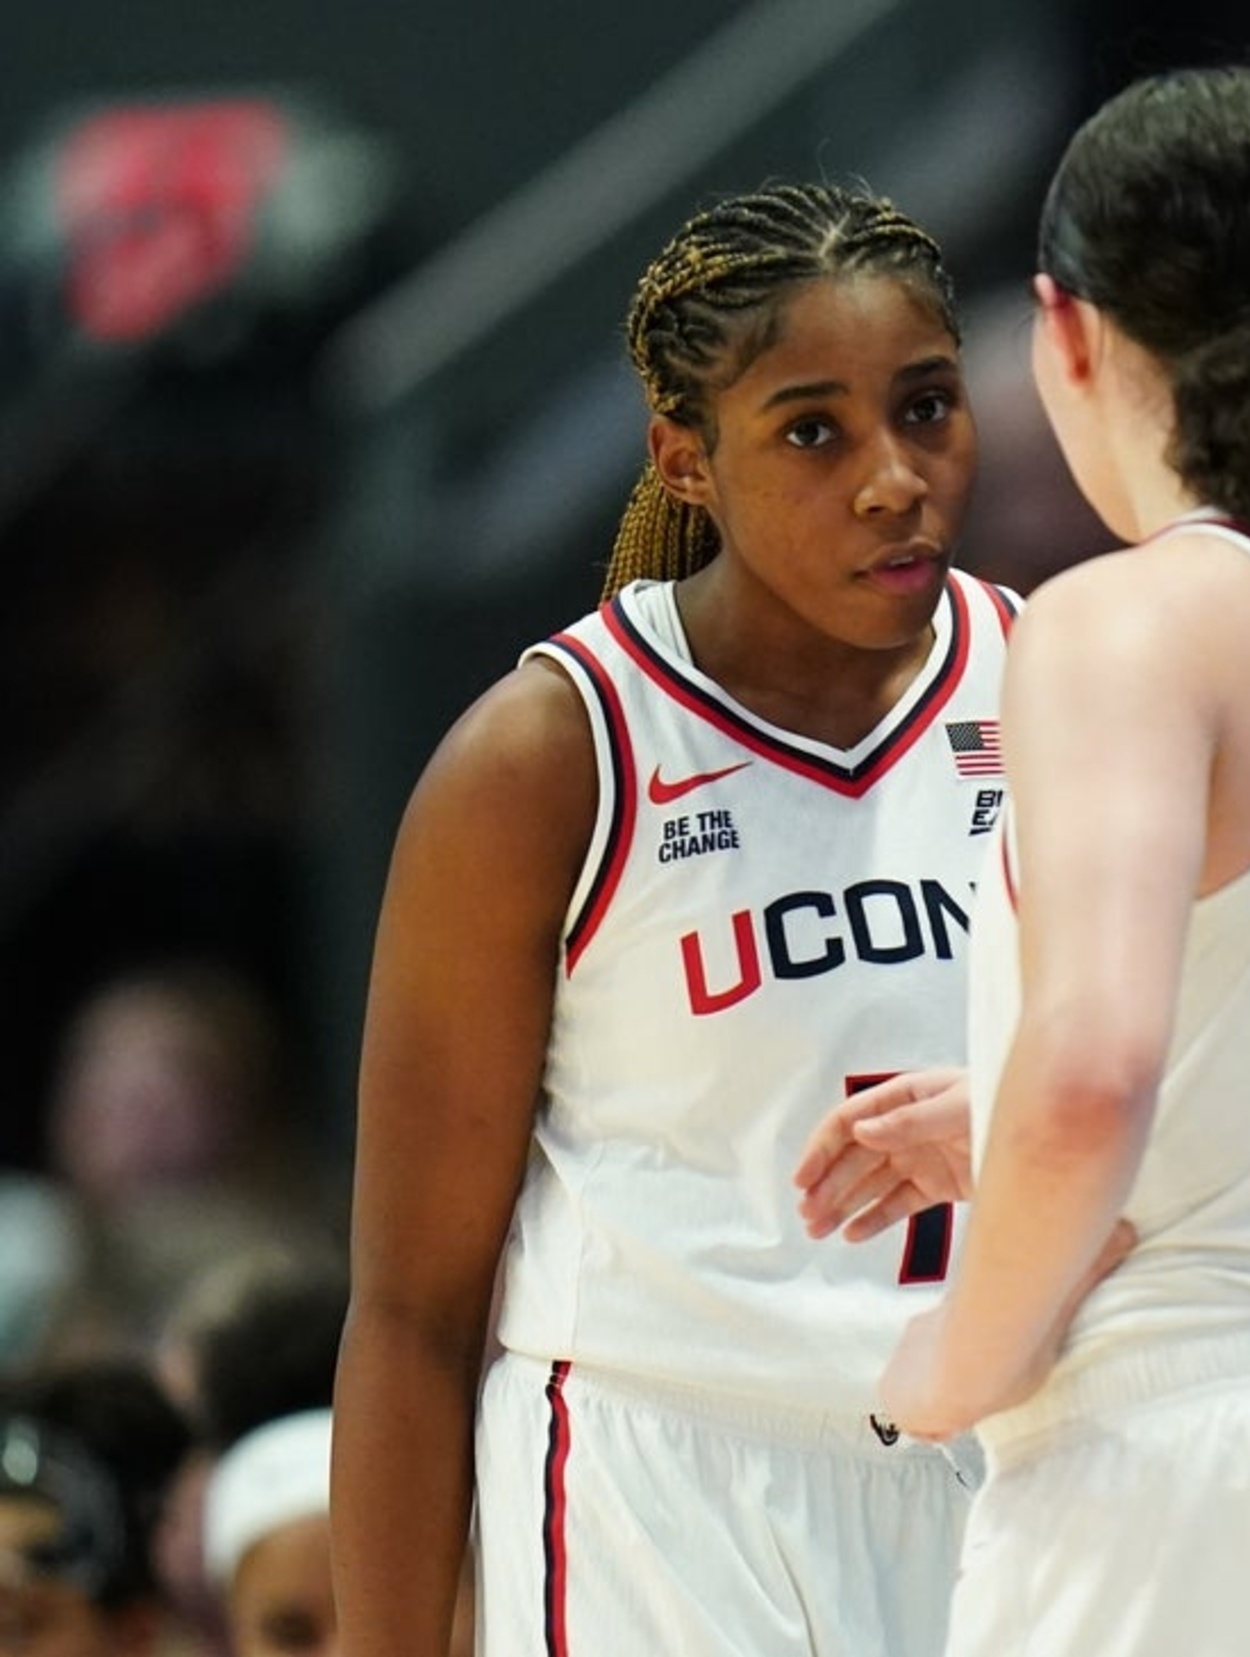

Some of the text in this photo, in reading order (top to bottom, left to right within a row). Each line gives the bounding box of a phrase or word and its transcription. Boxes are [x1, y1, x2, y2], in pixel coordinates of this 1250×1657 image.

[976, 789, 1003, 808] BI
[663, 809, 734, 841] BE THE
[658, 829, 741, 864] CHANGE
[680, 879, 978, 1016] UCON
